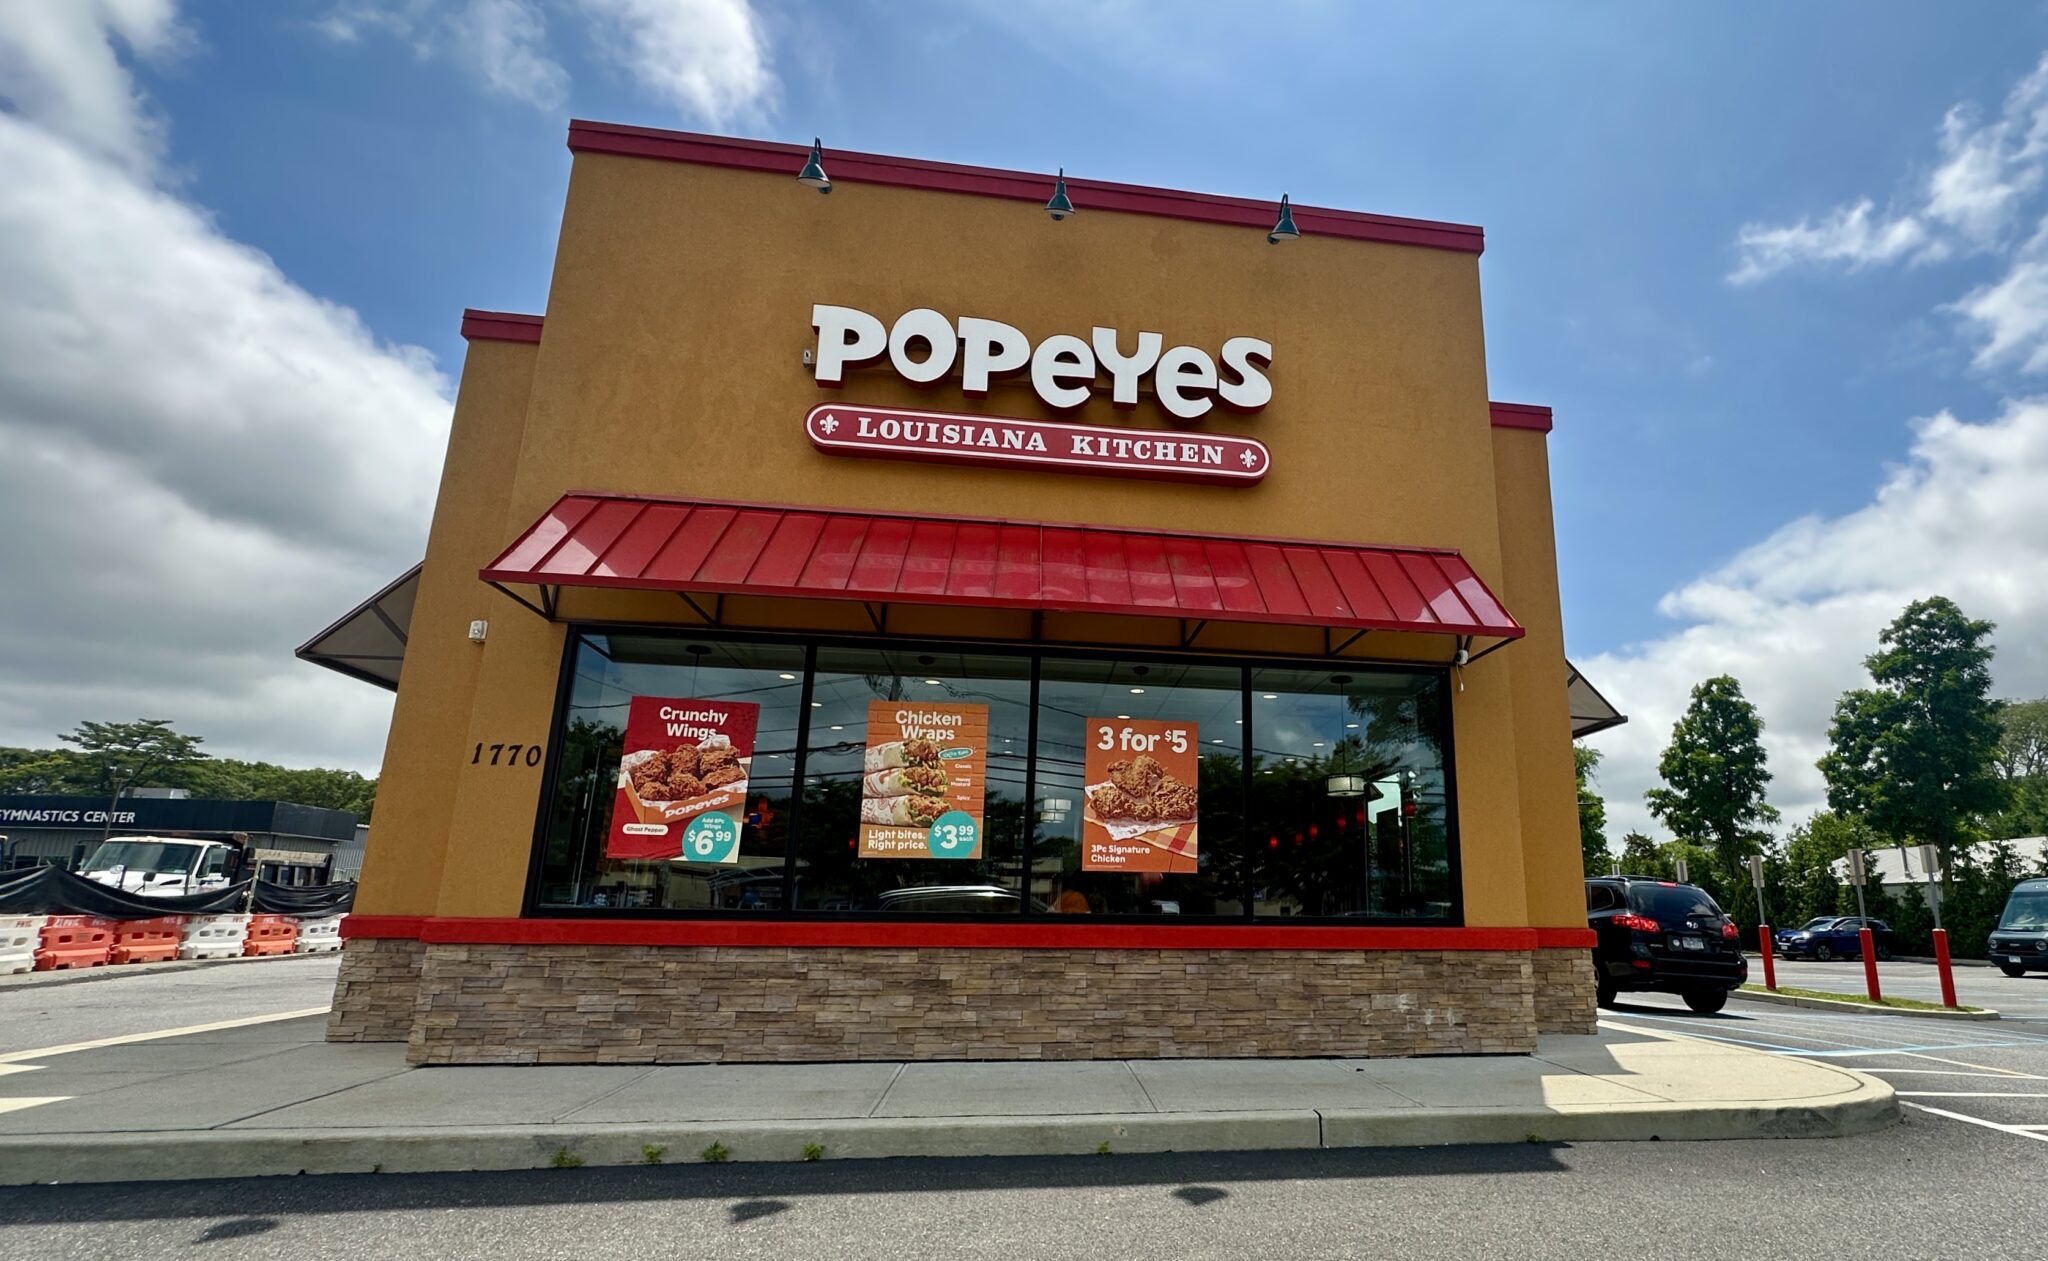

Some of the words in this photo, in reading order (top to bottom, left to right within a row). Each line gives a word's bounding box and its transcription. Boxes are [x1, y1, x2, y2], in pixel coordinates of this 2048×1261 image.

[857, 417, 1047, 452] LOUISIANA
[1071, 435, 1224, 465] KITCHEN
[659, 706, 728, 725] Crunchy
[895, 710, 962, 726] Chicken
[666, 723, 717, 741] Wings
[901, 725, 955, 742] Wraps
[1097, 726, 1114, 750] 3
[1119, 727, 1160, 751] for
[1164, 729, 1188, 753] $5
[471, 743, 542, 767] 1770
[83, 811, 136, 823] CENTER
[868, 830, 896, 841] Light
[897, 830, 926, 840] bites.
[868, 839, 896, 850] Right
[897, 840, 927, 851] price.
[1091, 844, 1107, 853] 3Pc
[1108, 845, 1150, 855] Signature
[1091, 854, 1126, 863] Chicken
